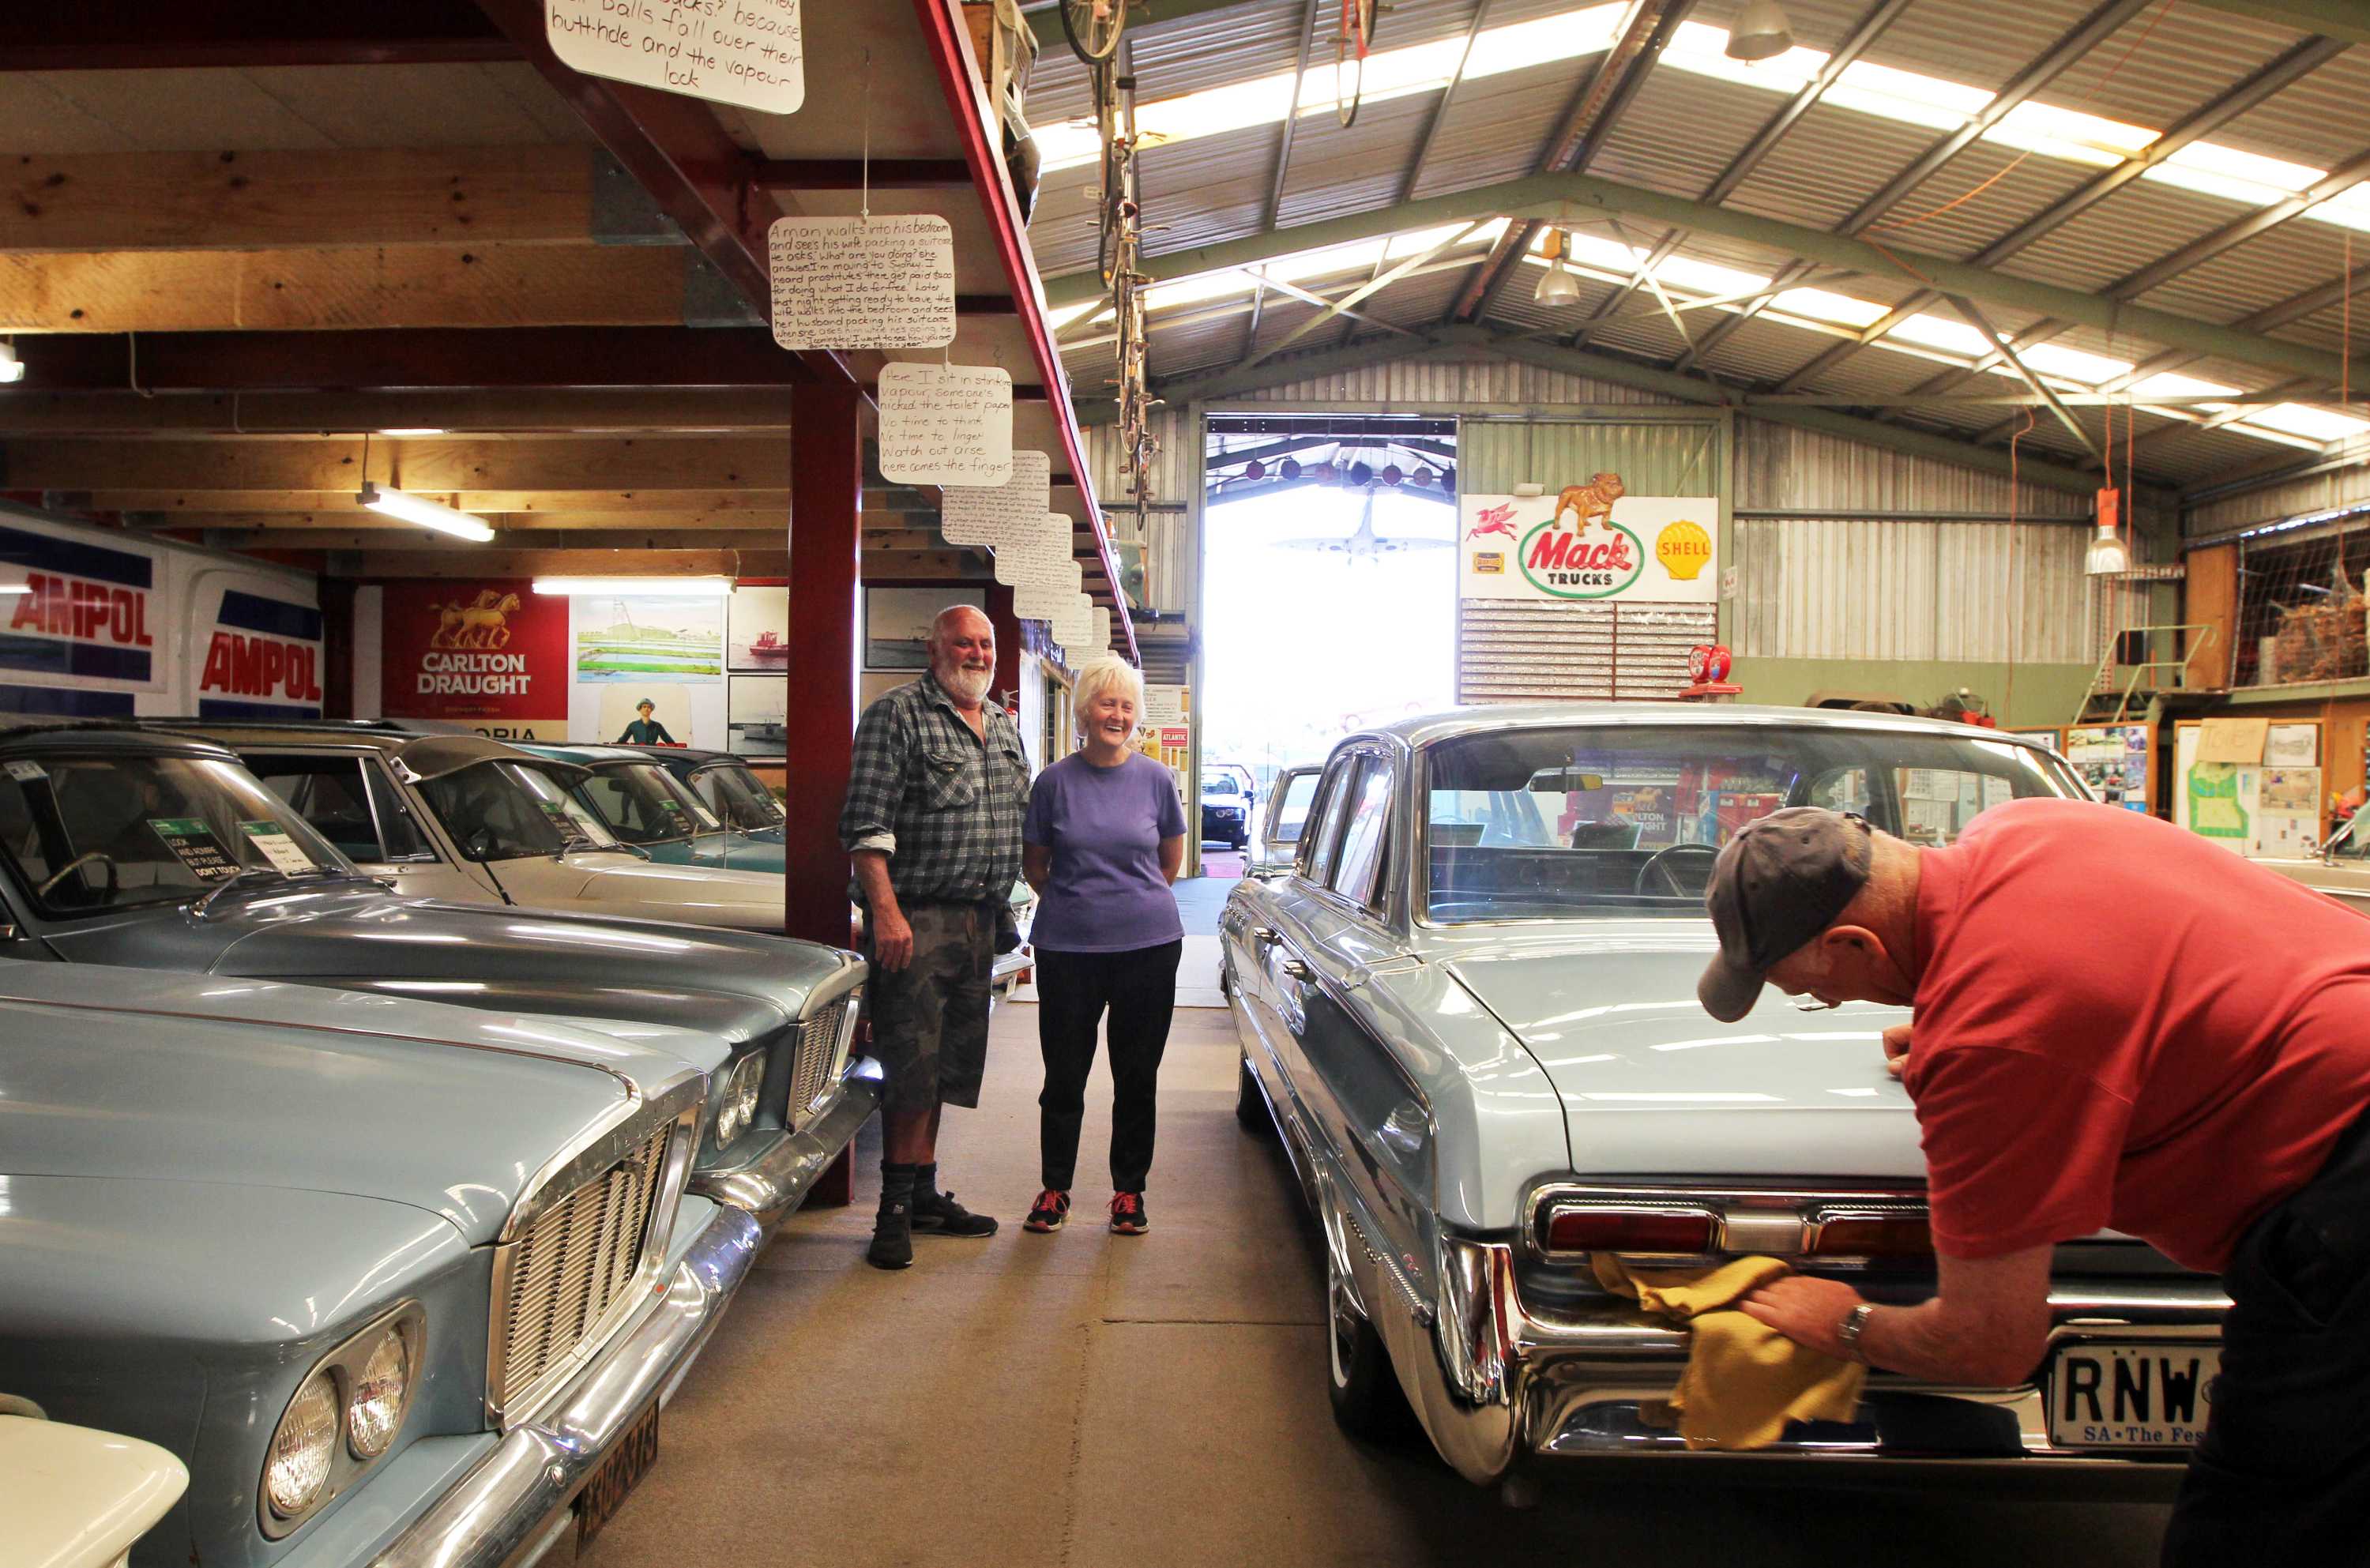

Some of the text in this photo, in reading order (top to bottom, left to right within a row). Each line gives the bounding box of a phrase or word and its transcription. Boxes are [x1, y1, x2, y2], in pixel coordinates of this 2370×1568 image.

[735, 2, 802, 41] because
[662, 8, 705, 38] fall
[713, 30, 755, 51] over
[761, 44, 803, 65] their
[642, 36, 681, 58] and
[687, 47, 716, 70] the
[725, 60, 790, 87] vapour
[665, 61, 699, 88] lock
[770, 218, 948, 238] A man walks into his bedroom
[770, 237, 792, 250] and
[822, 237, 838, 250] his
[865, 237, 905, 251] packing
[870, 251, 885, 262] you
[919, 250, 937, 258] she
[925, 258, 935, 267] I
[772, 274, 803, 284] heard
[890, 272, 907, 282] get
[909, 271, 931, 284] paid
[771, 284, 785, 295] for
[788, 284, 814, 297] doing
[818, 283, 842, 293] what
[845, 284, 854, 292] I
[856, 282, 868, 292] do
[870, 281, 885, 292] for
[863, 294, 892, 306] ready
[893, 295, 905, 303] to
[908, 294, 933, 303] leave
[935, 293, 952, 303] the
[797, 306, 824, 316] walks
[867, 304, 910, 314] bedroom
[912, 304, 932, 314] and
[774, 319, 792, 329] her
[797, 316, 843, 326] husband
[846, 318, 883, 328] packing
[887, 314, 902, 323] his
[886, 370, 913, 382] Here
[917, 370, 934, 385] I
[938, 373, 955, 383] sit
[961, 374, 972, 384] in
[880, 399, 1011, 414] nicked the toilet paper
[882, 416, 983, 427] No time to think
[900, 430, 924, 441] time
[931, 431, 944, 441] to
[954, 428, 984, 445] linger
[882, 445, 986, 457] Watch out arse
[882, 461, 908, 472] here
[943, 458, 965, 471] the
[969, 457, 1010, 477] finger
[1527, 532, 1632, 570] Mack
[1662, 541, 1710, 556] SHELL
[1548, 573, 1613, 586] TRUCKS
[10, 573, 152, 646] AMPOL
[200, 632, 322, 701] AMPOL
[422, 652, 525, 672] CARLTON
[417, 674, 532, 694] DRAUGHT
[2065, 1357, 2200, 1423] RNW
